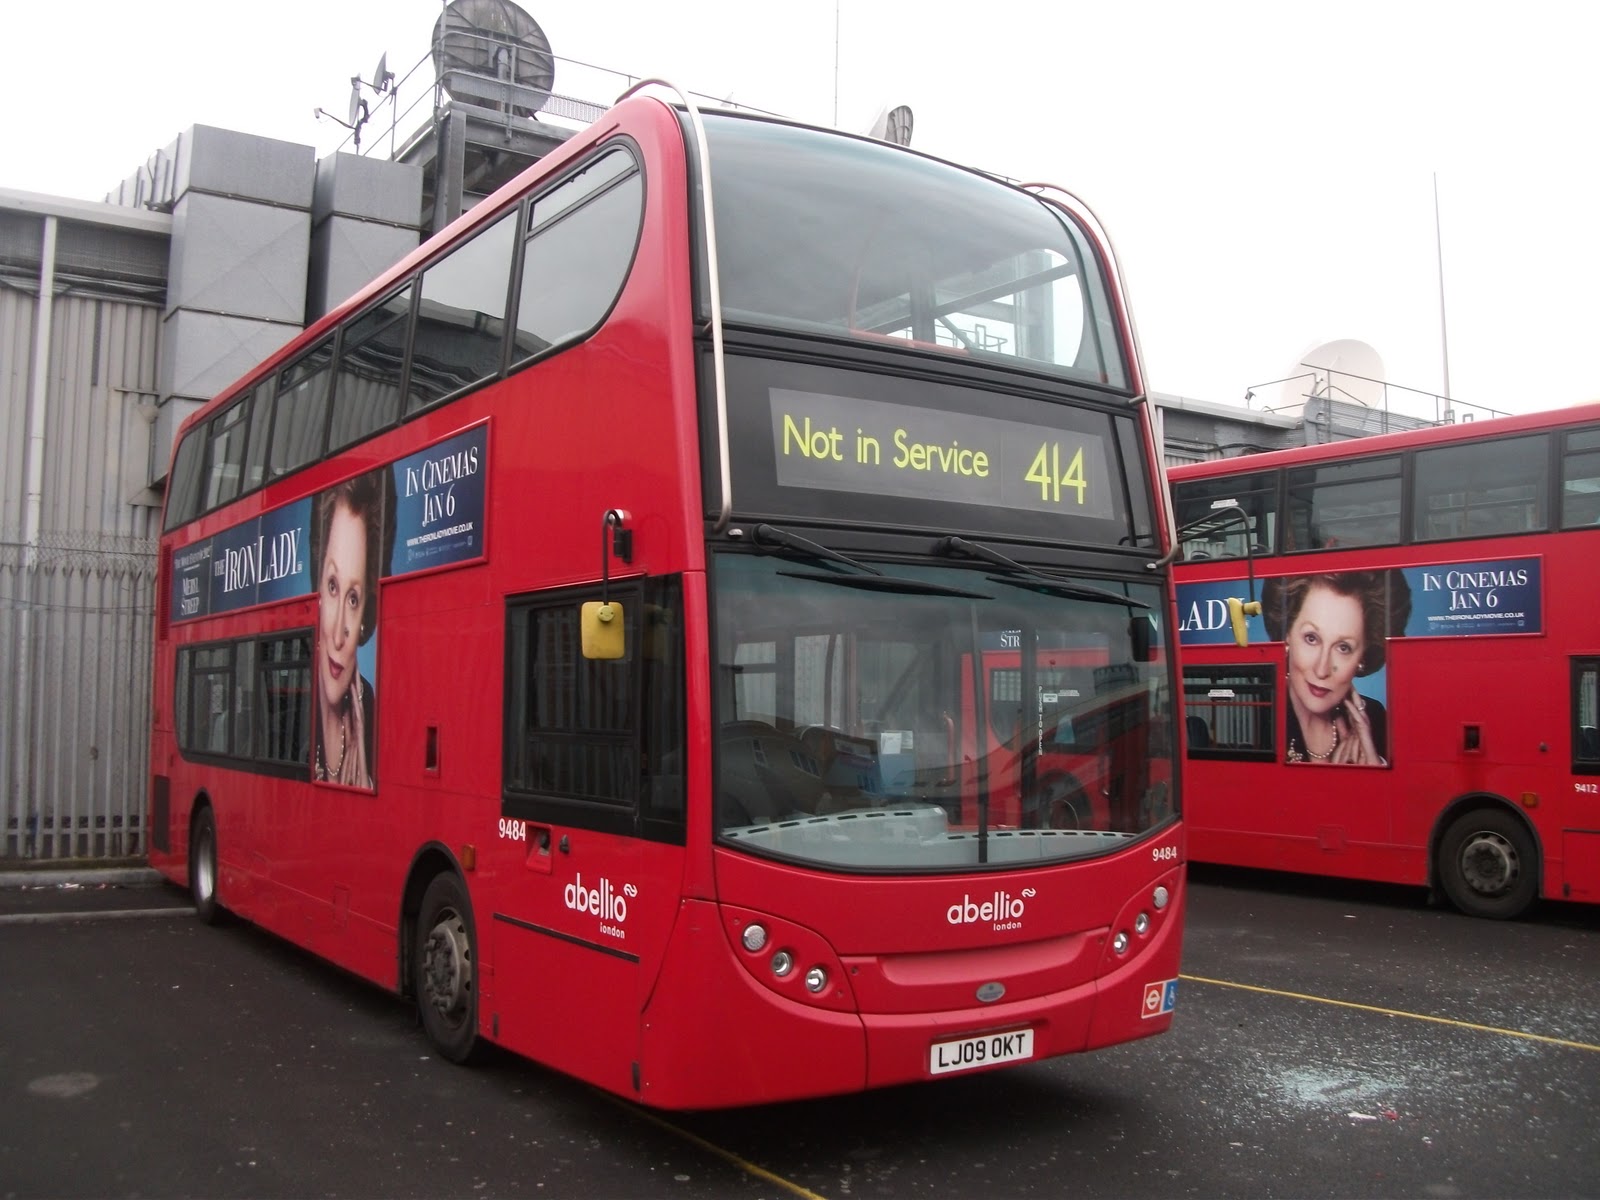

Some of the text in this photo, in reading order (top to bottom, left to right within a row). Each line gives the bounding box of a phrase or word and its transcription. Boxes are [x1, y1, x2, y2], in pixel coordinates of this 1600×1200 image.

[783, 413, 989, 478] Not in Service
[405, 446, 478, 498] IN CINEMAS
[1024, 441, 1087, 505] 414
[422, 483, 456, 527] JAN 6
[223, 543, 258, 593] IRON
[258, 528, 302, 584] LADY
[1423, 569, 1528, 591] IN CINEMAS
[1449, 588, 1498, 611] JAN 6
[1574, 782, 1598, 794] 9412
[499, 818, 527, 842] 9484
[1152, 846, 1178, 861] 9484
[564, 872, 627, 923] abellio
[946, 891, 1025, 925] abellio
[599, 922, 625, 939] london
[993, 920, 1022, 931] london
[938, 1033, 1027, 1068] LJ09 OKT
